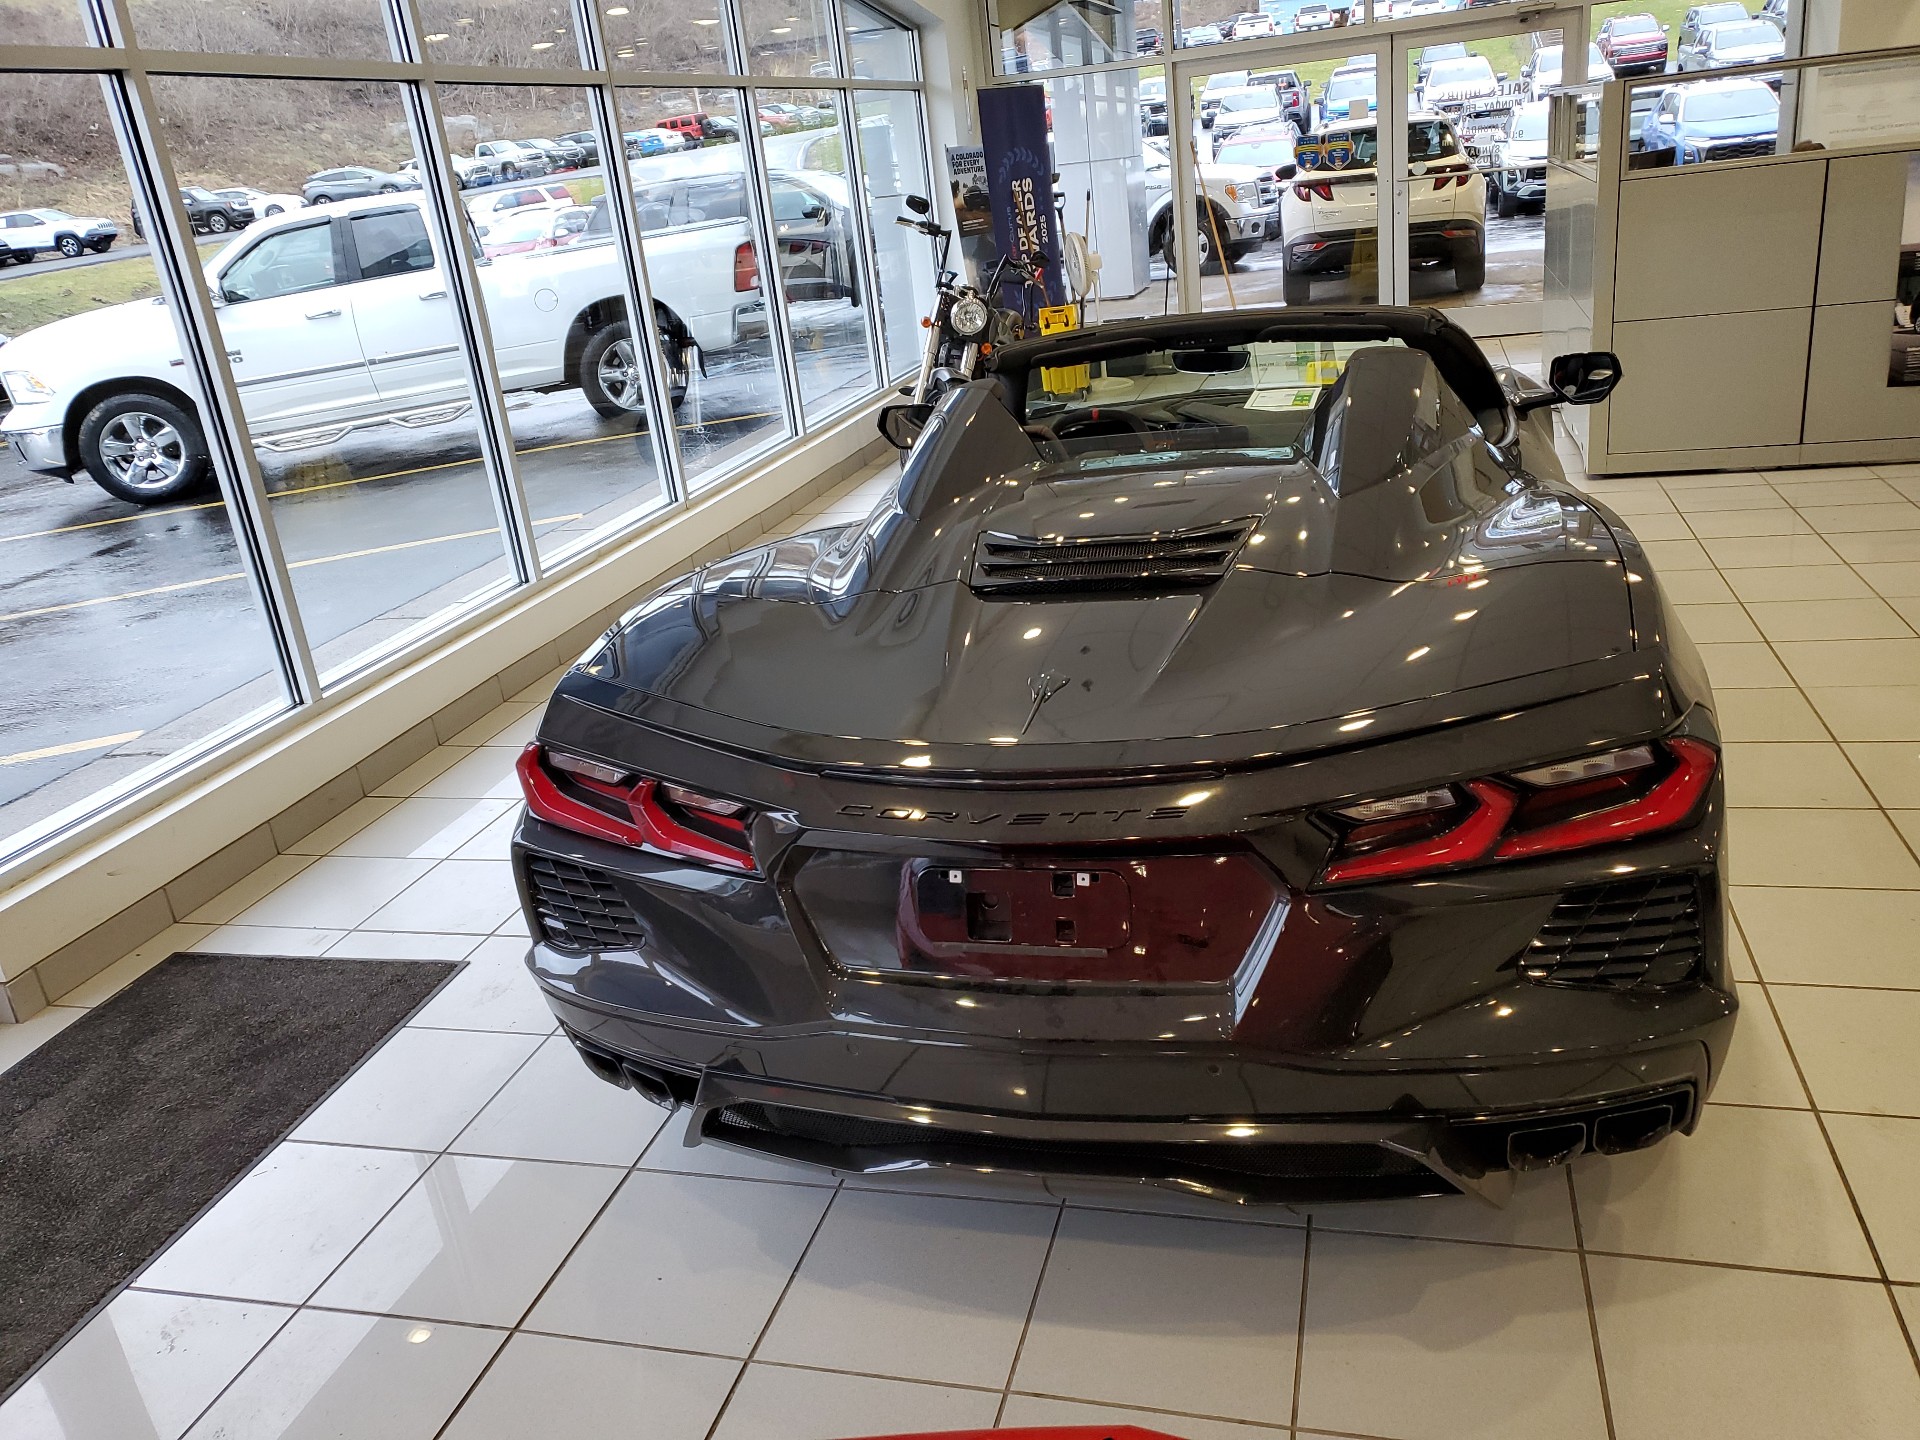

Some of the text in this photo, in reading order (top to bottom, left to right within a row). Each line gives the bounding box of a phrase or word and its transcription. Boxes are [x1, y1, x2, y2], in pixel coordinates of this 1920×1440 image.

[952, 159, 980, 169] FOR EVERY
[956, 151, 984, 161] COLORADO
[953, 165, 985, 175] ADVENTURE
[1011, 178, 1029, 251] DEALER
[1022, 177, 1041, 254] ARDS
[1006, 207, 1018, 259] arGurus
[1040, 214, 1049, 244] 2025
[835, 803, 1191, 826] CORVETTE
